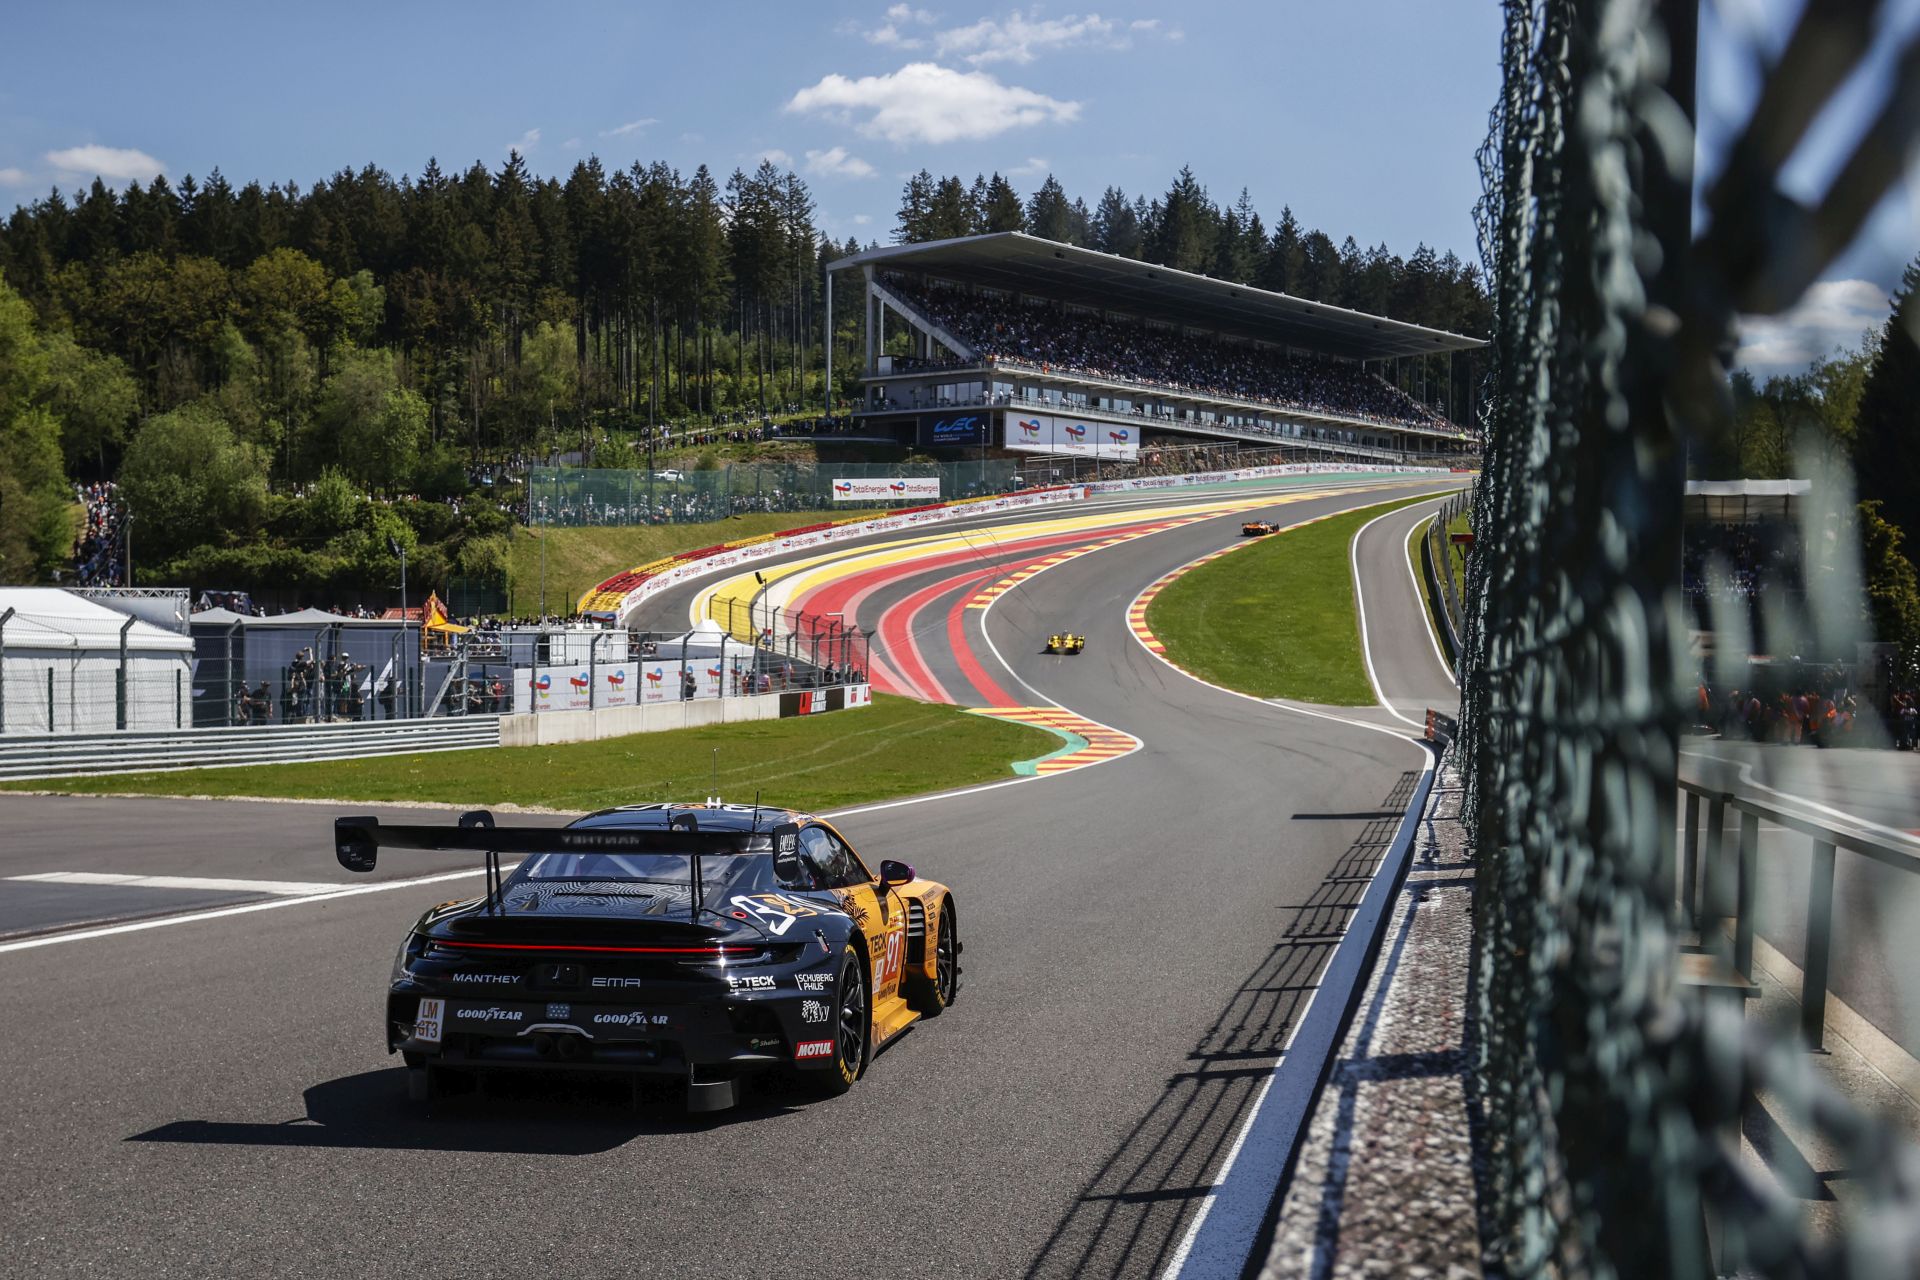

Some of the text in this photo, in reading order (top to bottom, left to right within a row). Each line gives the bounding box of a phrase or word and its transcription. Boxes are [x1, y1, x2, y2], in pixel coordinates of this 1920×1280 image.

[934, 416, 977, 432] WEC
[852, 484, 939, 495] TotalEnergies TotalEnergies
[885, 931, 900, 975] 91
[452, 973, 521, 984] MANTHEY
[799, 973, 834, 982] SCHUBERG
[803, 982, 824, 991] PHILIS
[422, 1001, 439, 1020] LM
[457, 1007, 523, 1021] GOODYEAR
[418, 1020, 438, 1038] GT3
[797, 1042, 832, 1057] MOTUL
